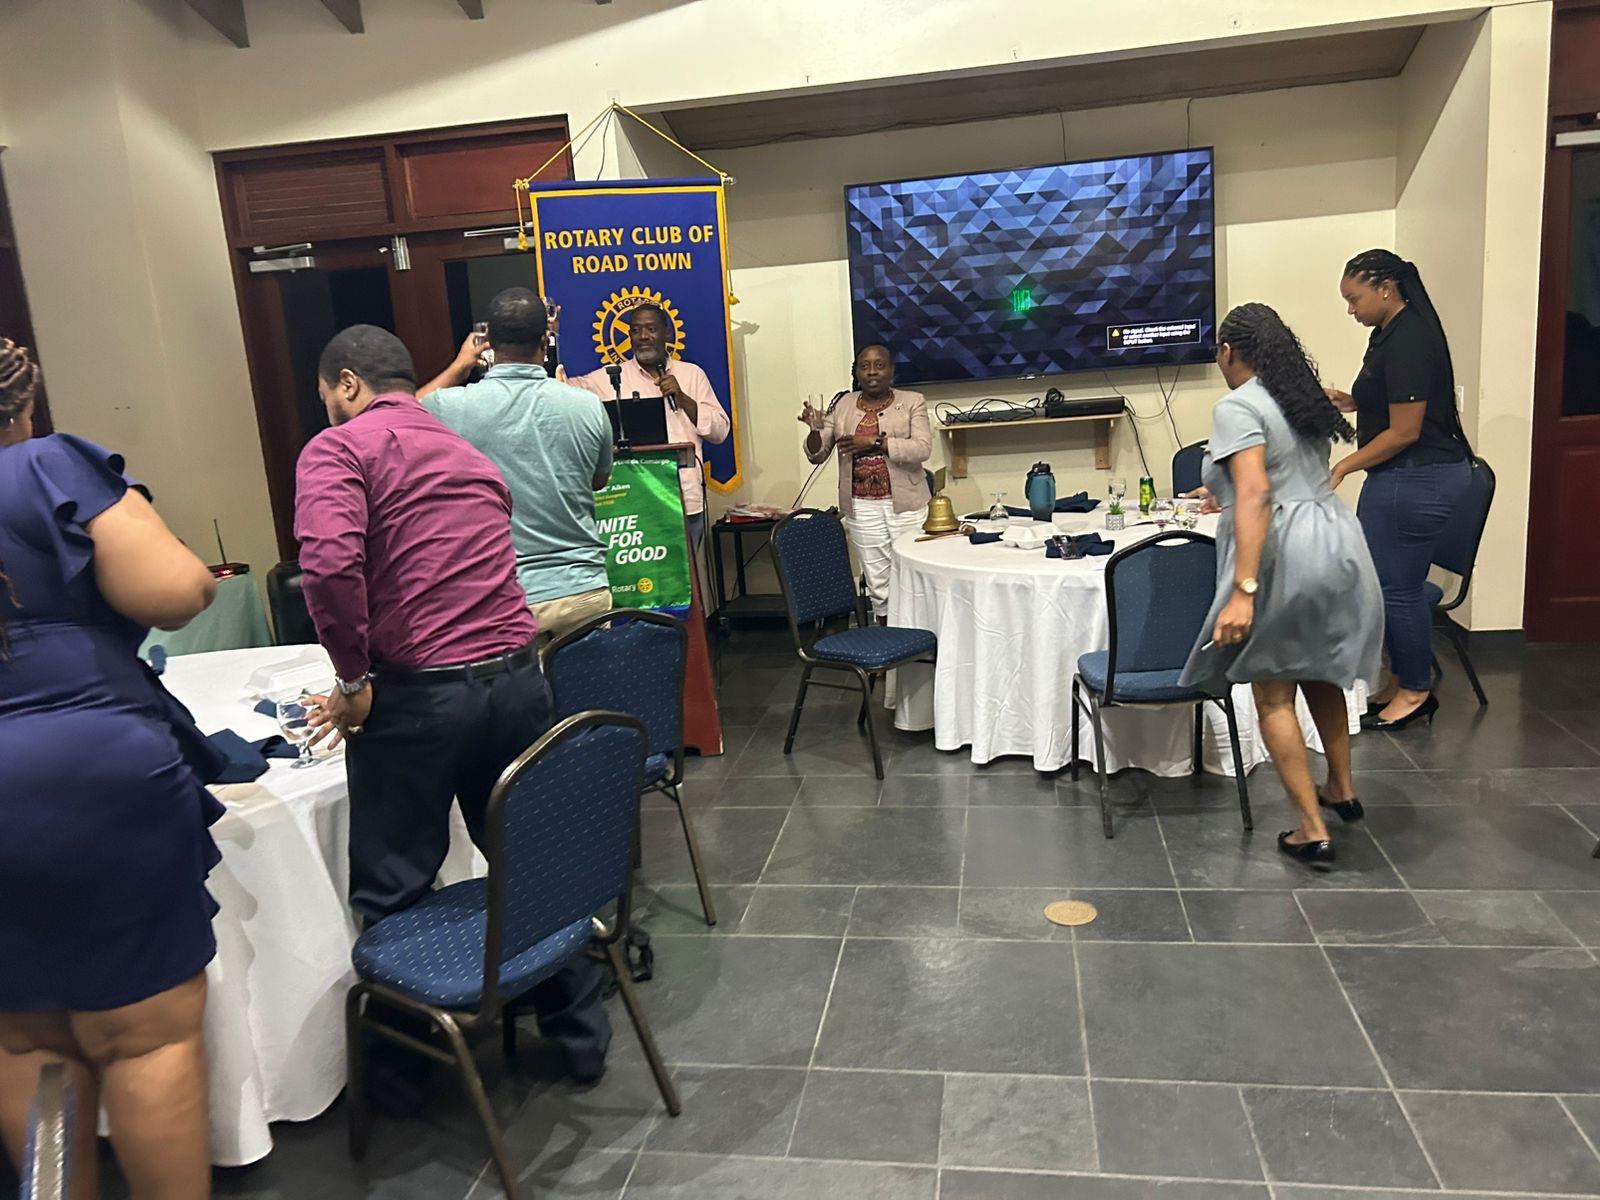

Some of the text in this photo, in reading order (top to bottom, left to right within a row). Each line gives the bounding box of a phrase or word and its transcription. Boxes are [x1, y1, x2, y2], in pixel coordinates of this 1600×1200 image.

[544, 225, 713, 249] ROTARY CLUB OF
[572, 252, 692, 273] ROAD TOWN
[608, 531, 643, 549] FOR
[615, 545, 667, 565] GOOD
[611, 584, 636, 594] Rotary
